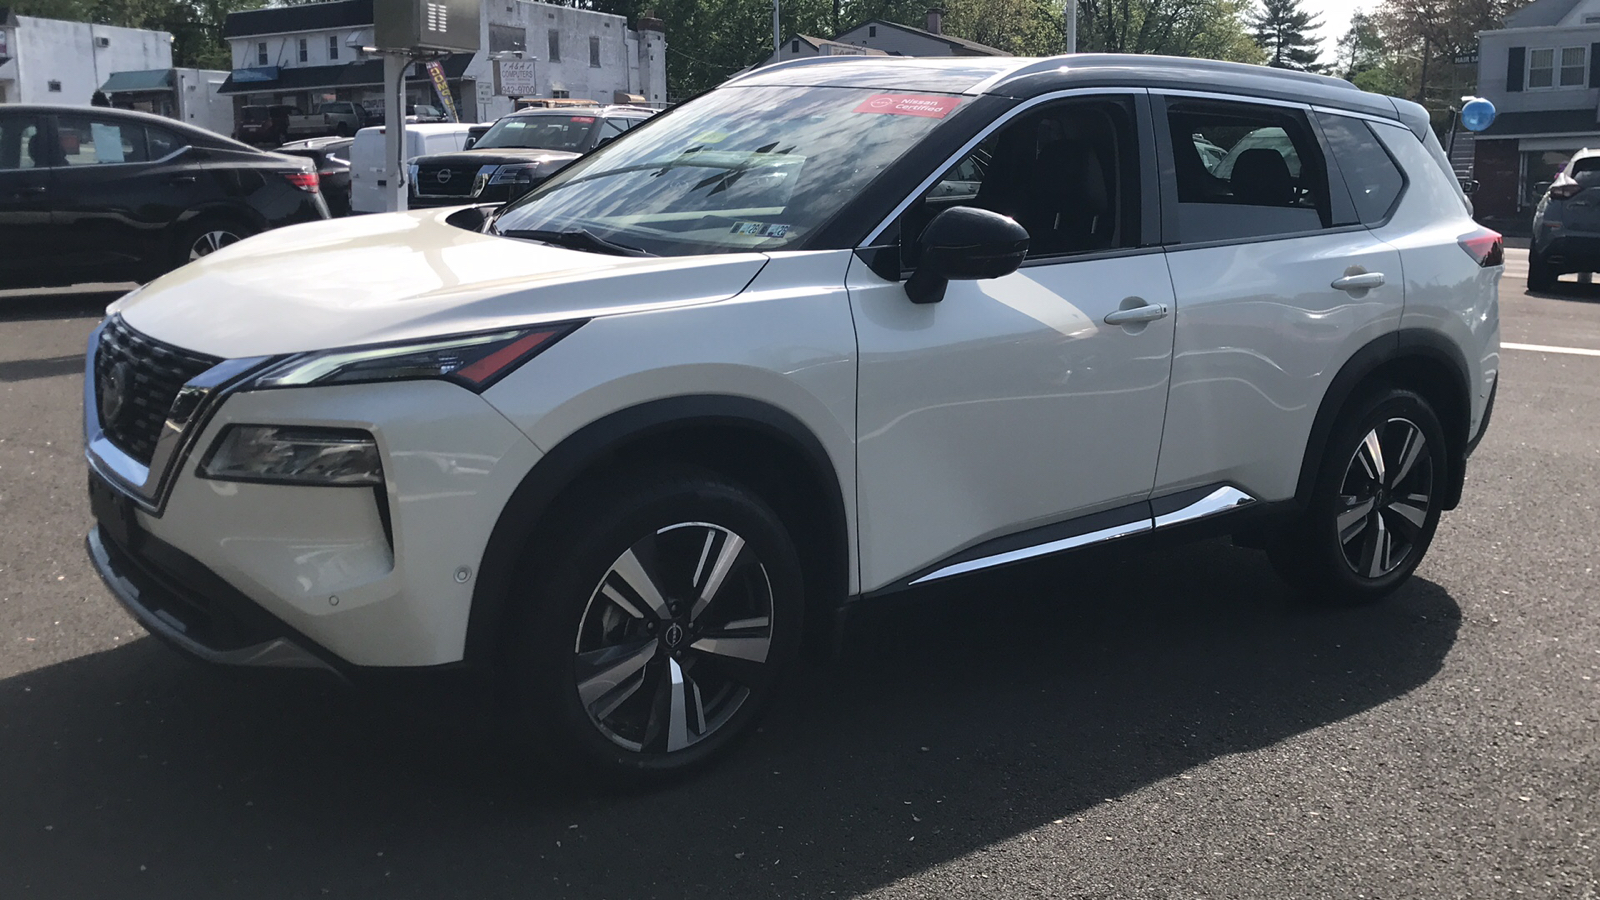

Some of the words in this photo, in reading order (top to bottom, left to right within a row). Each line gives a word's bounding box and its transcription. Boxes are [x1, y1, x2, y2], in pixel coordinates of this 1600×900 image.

[502, 70, 533, 78] COMPUTERS
[501, 85, 535, 94] 942-9700
[901, 98, 938, 106] Nissan
[895, 103, 944, 112] Certified
